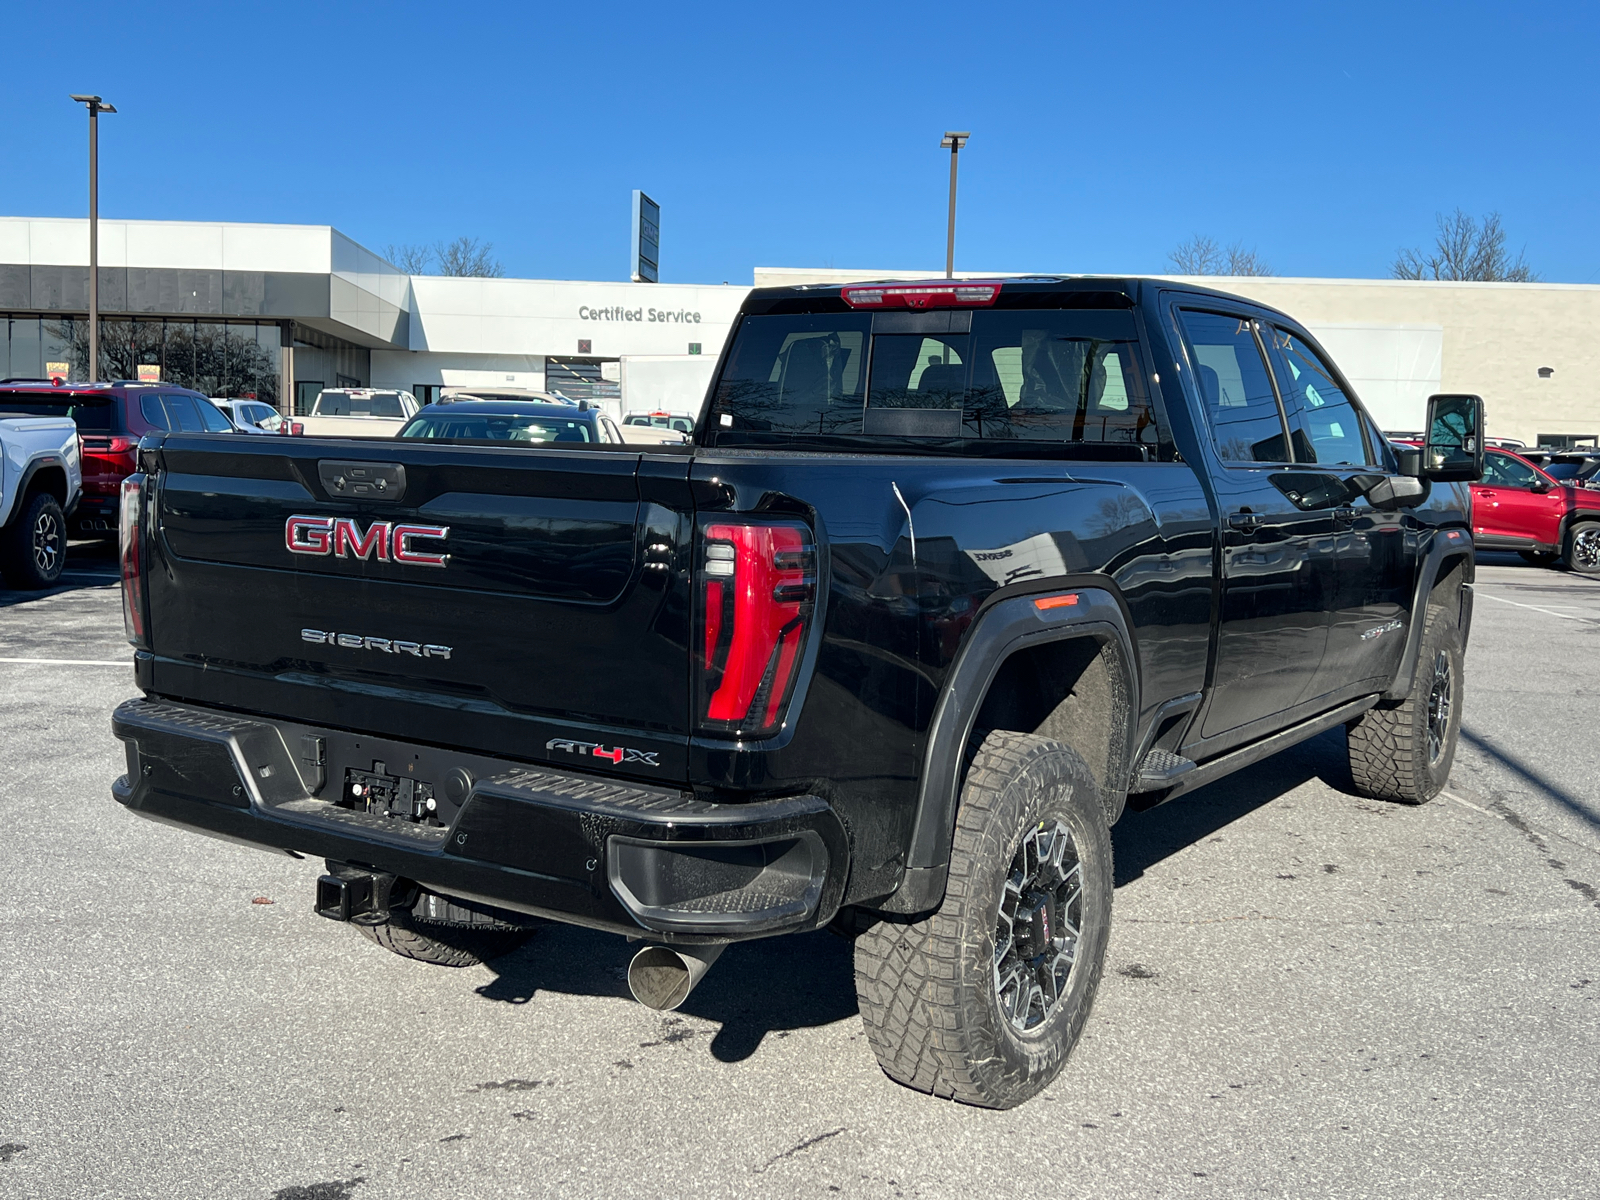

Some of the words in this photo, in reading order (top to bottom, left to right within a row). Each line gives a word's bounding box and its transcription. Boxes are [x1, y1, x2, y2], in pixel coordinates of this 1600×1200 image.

[579, 306, 642, 321] Certified
[648, 308, 701, 323] Service
[286, 514, 451, 568] GMC
[300, 628, 453, 661] SIERRA
[545, 737, 661, 768] AT4X
